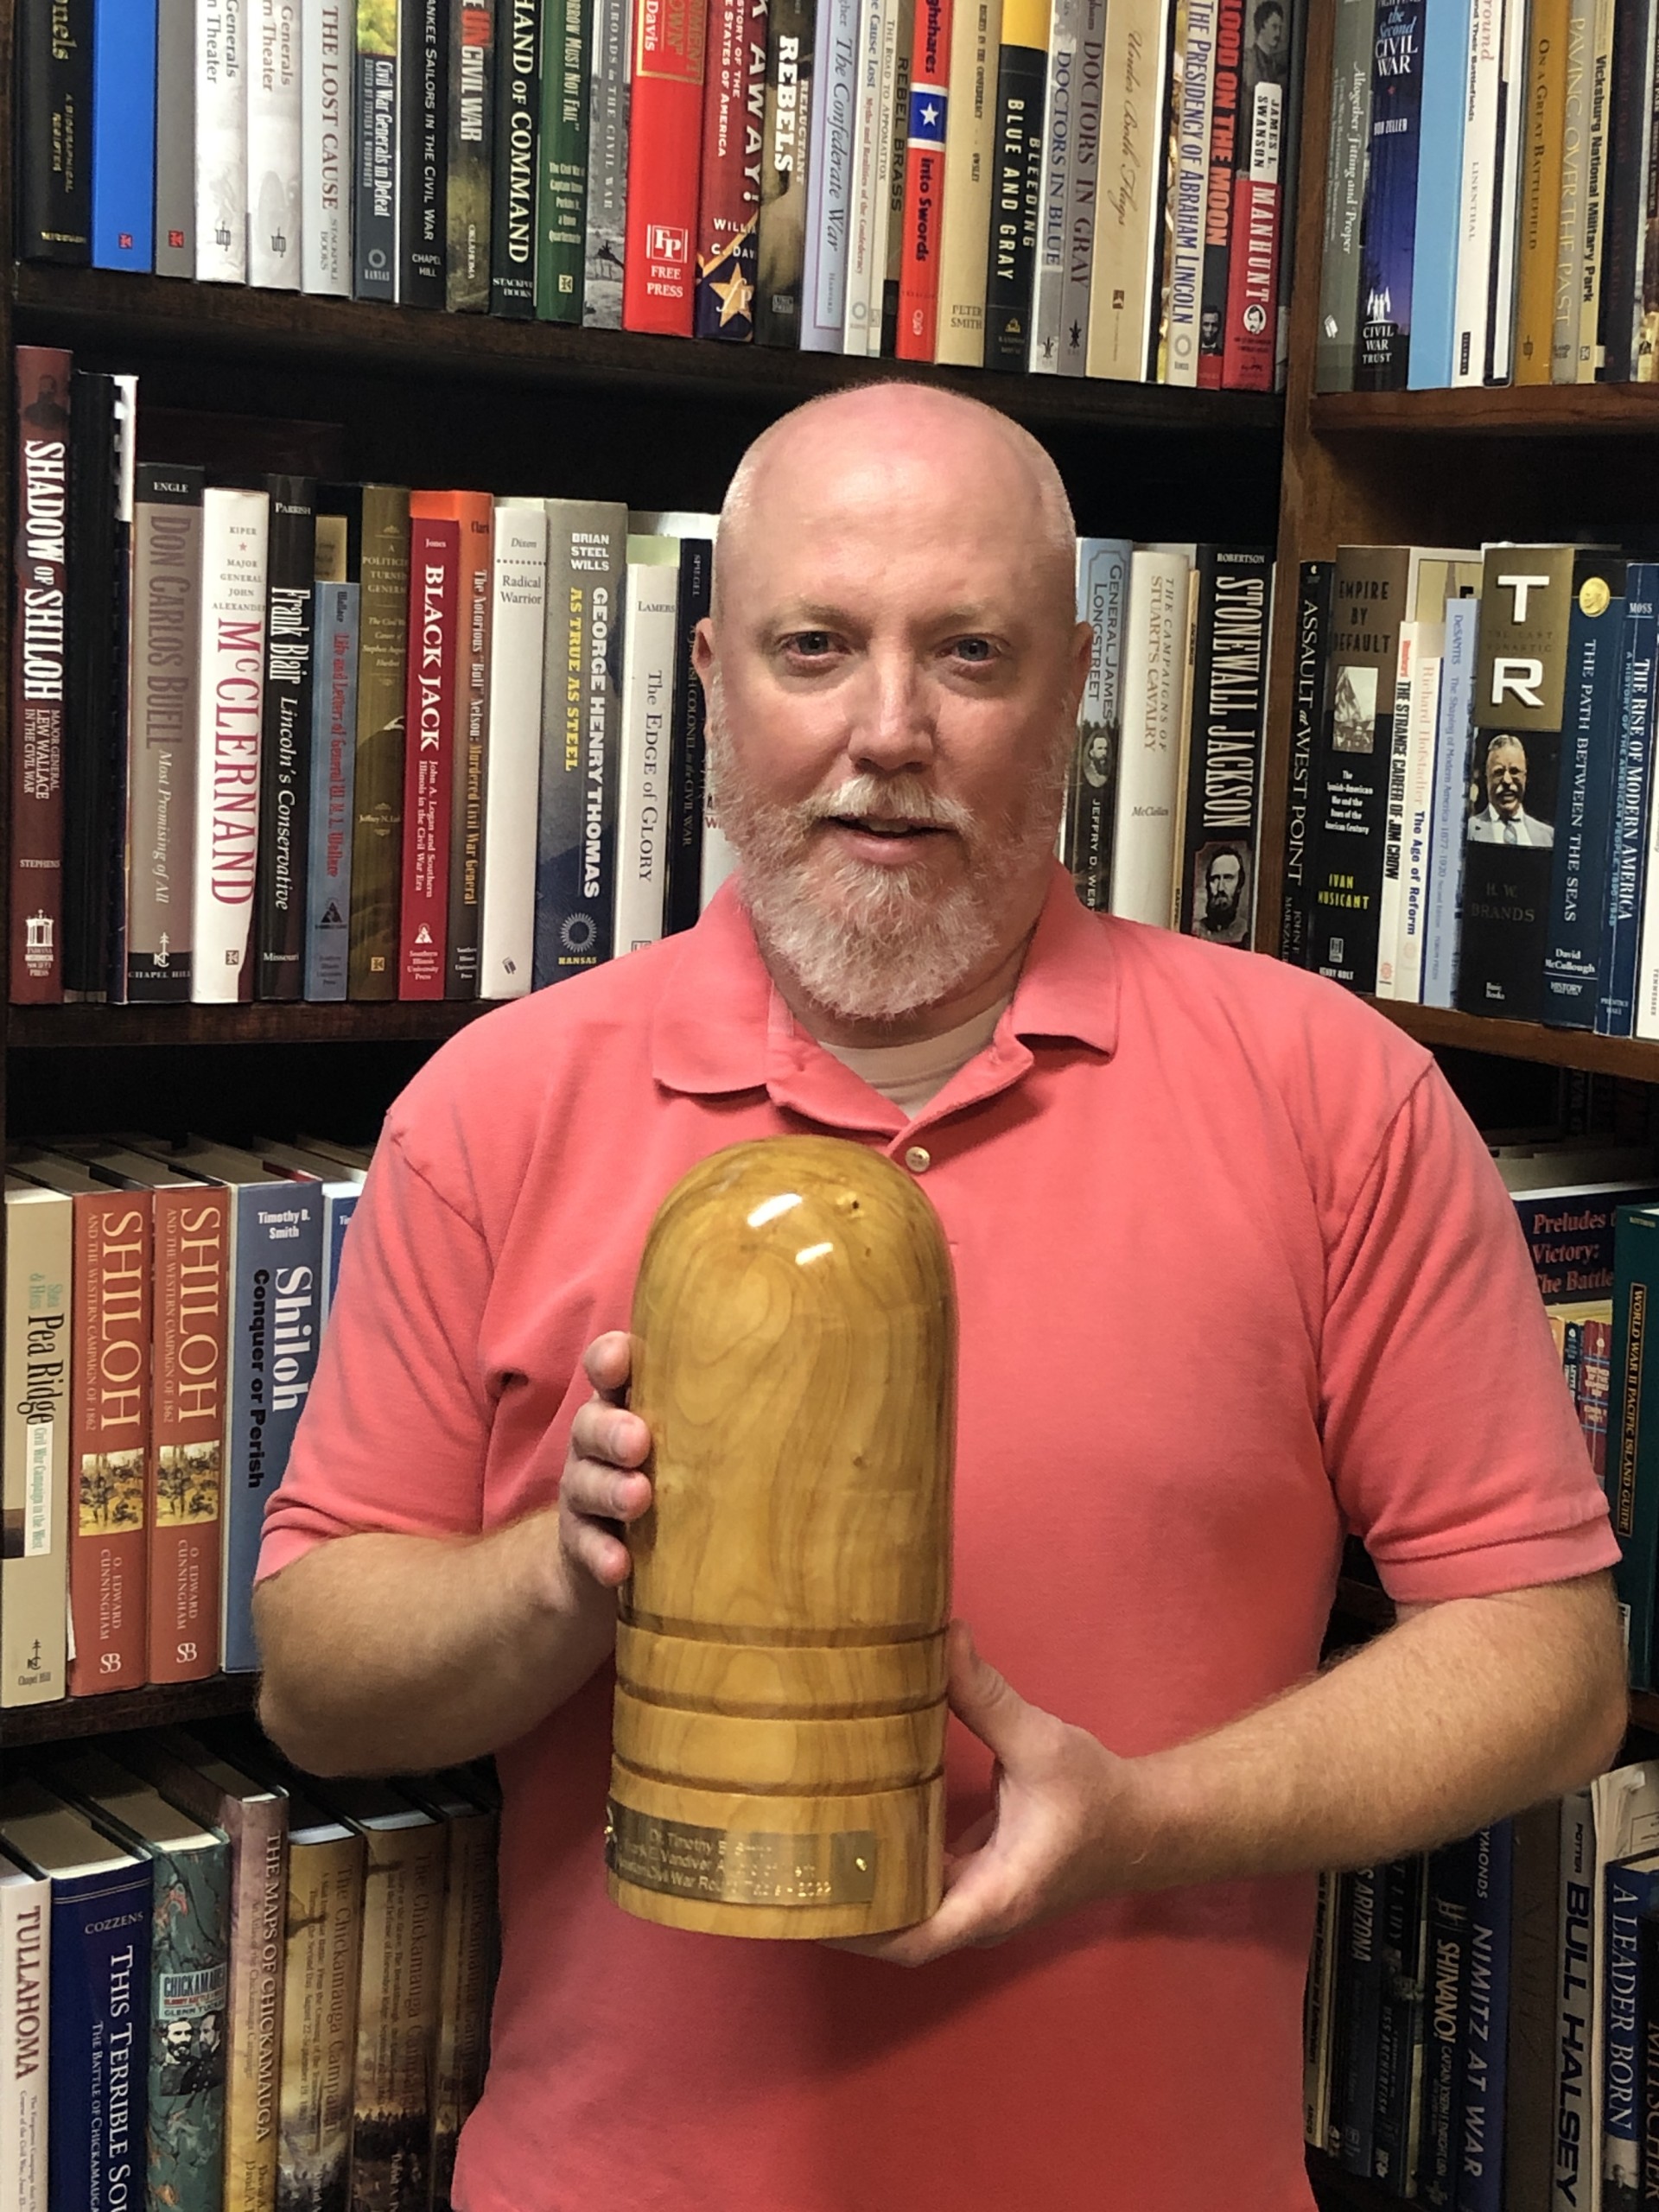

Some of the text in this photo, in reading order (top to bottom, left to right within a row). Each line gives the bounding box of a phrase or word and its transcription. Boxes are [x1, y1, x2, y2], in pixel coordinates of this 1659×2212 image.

[207, 15, 221, 83] Theater
[263, 23, 276, 92] Theater
[282, 6, 293, 86] Generals
[644, 1, 659, 51] Davis
[1375, 33, 1420, 59] CIVIL
[424, 48, 437, 109] SAILORS
[1350, 61, 1366, 131] Altogether
[1376, 56, 1412, 76] WAR
[322, 6, 339, 210] THE LOST CAUSE
[424, 114, 435, 128] IN
[743, 43, 768, 204] AWAY!
[774, 35, 798, 172] REBELS
[796, 79, 810, 185] RELUCTANT
[891, 57, 909, 213] REBEL BRASS
[1254, 96, 1268, 168] SWANSON
[424, 135, 435, 162] THE
[825, 37, 854, 251] The Confederate War
[919, 157, 935, 192] into
[1046, 50, 1072, 265] DOCTORS IN BLUE
[1070, 41, 1103, 289] DOCTORS IN GRAY
[1172, 2, 1214, 324] THE PRESIDENCY OF ABRAHAM LINCOLN
[1582, 55, 1608, 302] Vicksburg National Military Park
[423, 166, 436, 203] CIVIL
[996, 99, 1020, 280] BLUE AND GRAY
[1022, 137, 1041, 247] BLEEDING
[1345, 180, 1358, 205] and
[423, 209, 435, 240] WAR
[916, 197, 931, 262] Swords
[1245, 186, 1276, 303] MANHUNT
[1341, 209, 1357, 254] Proper
[647, 283, 683, 297] PRESS
[651, 266, 681, 280] FREE
[950, 317, 982, 329] SMITH
[952, 304, 982, 317] PETER
[1363, 325, 1394, 339] CIVIL
[1366, 340, 1389, 350] WAR
[1363, 352, 1392, 363] TRUST
[154, 481, 188, 493] ENGLE
[227, 559, 257, 568] MAJOR
[230, 526, 257, 535] KIPER
[426, 538, 447, 548] Jones
[571, 533, 609, 544] BRIAN
[571, 547, 609, 557] STEEL
[23, 440, 66, 702] SHADOW OF SHILOH
[229, 588, 255, 597] JOHN
[500, 592, 542, 605] Warrior
[502, 575, 541, 588] Radical
[571, 560, 609, 571] WILLS
[1497, 575, 1549, 623] T
[144, 515, 192, 751] DON CARLOS BUELL
[1629, 603, 1652, 613] MOSS
[418, 564, 445, 752] BLACK JACK
[1491, 657, 1545, 709] R
[1203, 575, 1264, 828] STONEWALL JACKSON
[583, 587, 608, 899] GEORGE HENRY THOMAS
[638, 670, 663, 883] The EDGE of GLORY
[1286, 599, 1320, 887] ASSAULT at WEST POINT
[1563, 639, 1597, 923] THE PATH BETWEEN THE SEAS
[1617, 658, 1650, 921] THE RISE OF MODERN AMERICA
[1329, 874, 1353, 889] IVAN
[1555, 948, 1581, 960] David
[269, 1226, 299, 1239] Smith
[1532, 1211, 1606, 1235] Preludes
[1532, 1243, 1599, 1264] Victory:
[100, 1211, 143, 1430] SHILOH
[162, 1209, 177, 1423] AND THE WESTERN CAMPAIGN OF 1862
[178, 1206, 221, 1423] SHILOH
[271, 1265, 313, 1413] Shiloh
[16, 1313, 64, 1425] Pea Ridge
[247, 1268, 270, 1488] Conquer or Perish
[1618, 1289, 1643, 1530] WORLD WAR II PACIFIC ISLAND GUIDE
[99, 1548, 111, 1640] CUNNINGHAM
[111, 1557, 123, 1630] O. EDWARD
[176, 1539, 188, 1630] CUNNINGHAM
[84, 1911, 143, 1935] COZZENS
[16, 1905, 41, 2080] TULLAHOMA
[255, 1830, 281, 2143] THE MAPS OF CHICKAMAUGA
[1468, 1923, 1494, 2042] NIMITZ
[1556, 1822, 1590, 2209] POTTER BULL HALSEY
[1608, 1883, 1638, 2130] A LEADER BORN
[1466, 2050, 1487, 2091] AT
[1462, 2105, 1485, 2177] WAR
